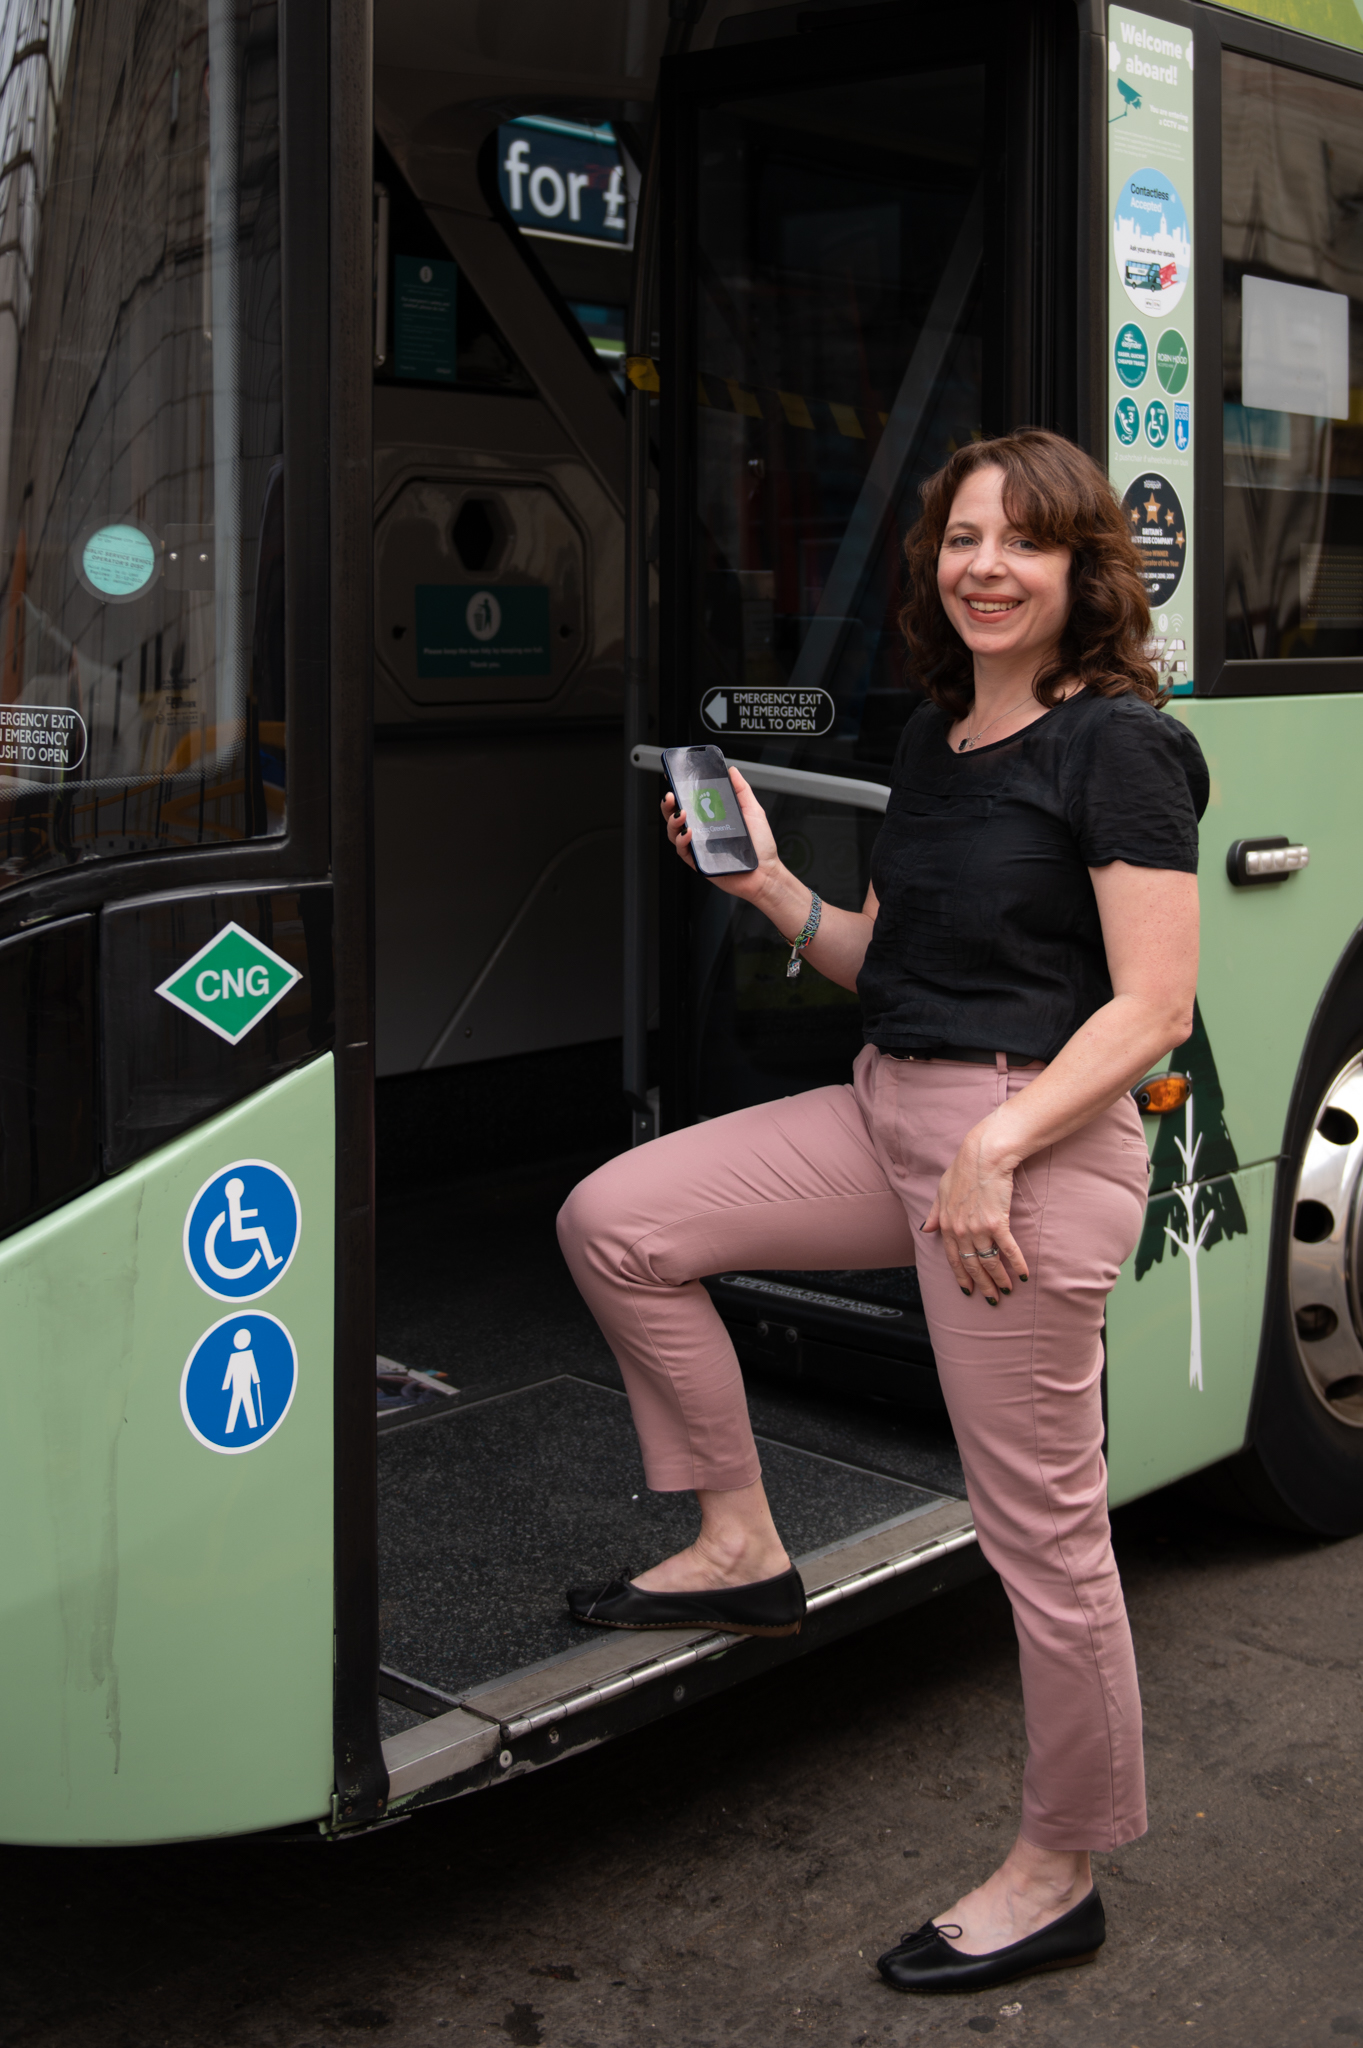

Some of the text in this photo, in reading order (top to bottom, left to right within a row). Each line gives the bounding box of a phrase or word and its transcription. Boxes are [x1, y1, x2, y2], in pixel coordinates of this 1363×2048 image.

[1120, 22, 1183, 60] Welcome
[1125, 54, 1178, 86] aboard!
[1149, 104, 1189, 124] You are entering
[1163, 118, 1178, 129] CCTV
[1177, 123, 1189, 133] area
[504, 140, 626, 231] for £
[1130, 183, 1169, 201] Contactless
[1130, 196, 1162, 213] Accepted
[1137, 246, 1146, 254] your
[1146, 247, 1157, 256] driver
[1163, 250, 1176, 259] details
[1157, 353, 1188, 365] ROBIN HOOD
[1175, 404, 1189, 413] GUIDE
[1128, 411, 1134, 423] 3
[1159, 414, 1164, 426] 1
[1175, 412, 1189, 421] DOGS
[1114, 451, 1119, 461] 2
[1119, 453, 1143, 463] pushchair
[1147, 455, 1172, 465] wheelchair
[1180, 459, 1189, 467] bus
[1142, 527, 1163, 537] BRITAIN'S
[1143, 536, 1152, 544] BUS
[1152, 537, 1174, 545] COMPANY
[92, 555, 145, 570] OPERATOR'S DISC
[105, 551, 130, 561] SERVICE
[1170, 560, 1179, 568] Year
[423, 647, 442, 655] Please
[733, 692, 823, 705] EMERGENCY EXIT
[739, 705, 817, 718] IN EMERGENCY
[51, 714, 76, 730] EXIT
[740, 718, 816, 731] PULL TO OPEN
[5, 728, 70, 746] EMERGENCY
[21, 746, 36, 761] TO
[38, 747, 69, 763] OPEN
[195, 965, 270, 1002] CNG
[735, 1276, 804, 1294] WHEELCHAIR
